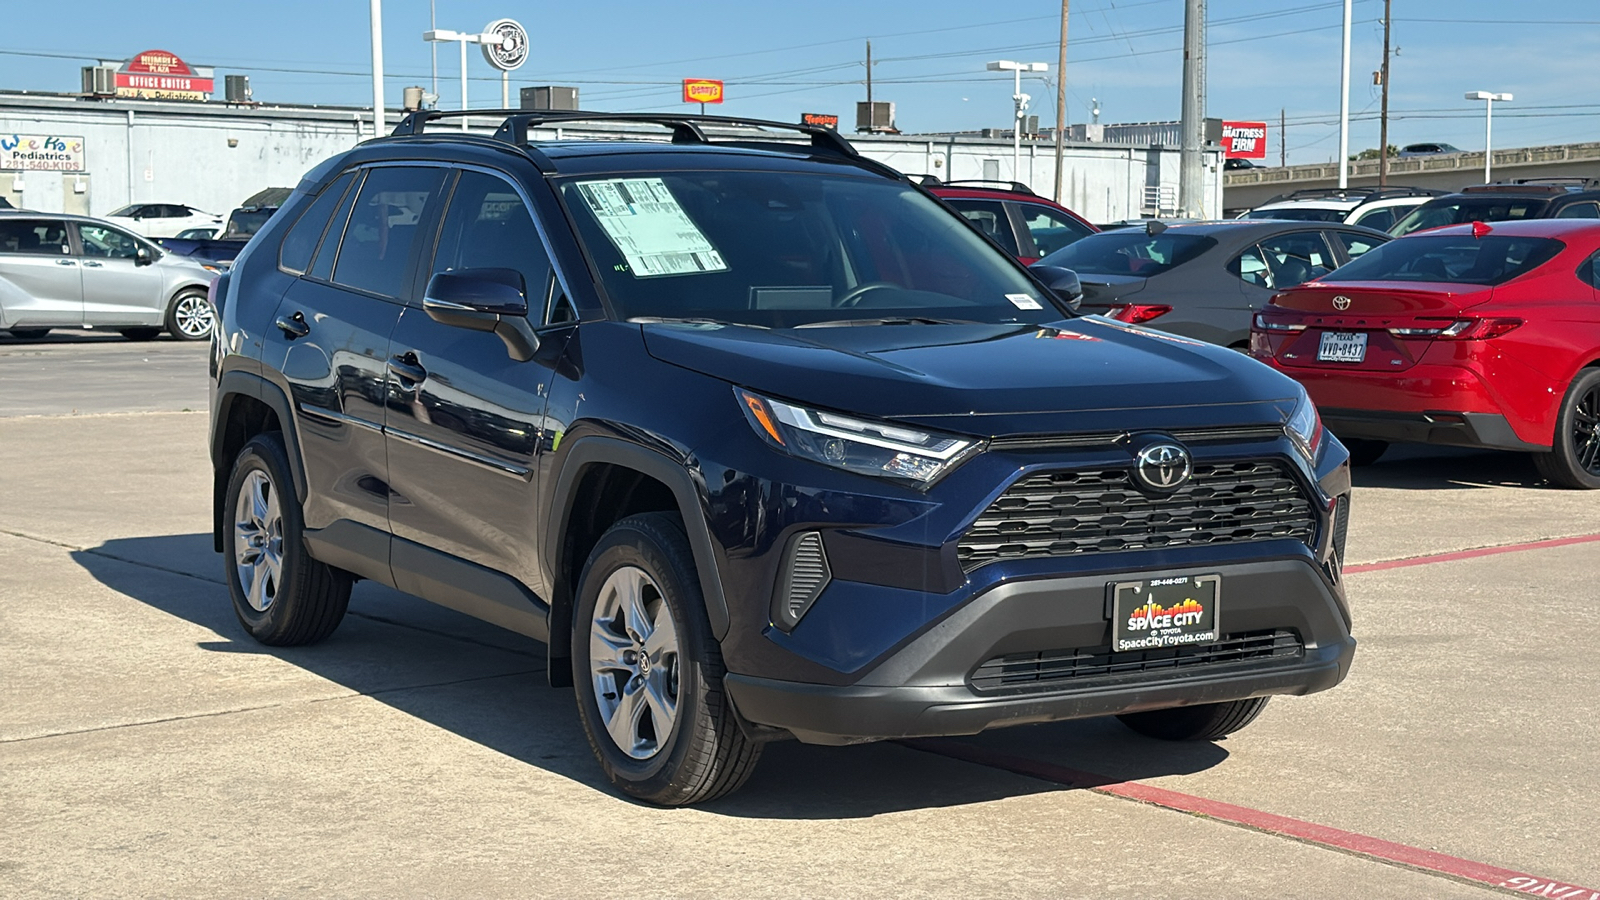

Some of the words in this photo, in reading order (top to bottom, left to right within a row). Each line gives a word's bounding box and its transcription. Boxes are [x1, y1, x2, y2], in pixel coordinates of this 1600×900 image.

[141, 55, 178, 67] HUMBLE
[149, 65, 170, 74] PLAZA
[129, 76, 158, 88] OFFICE
[161, 78, 191, 90] SUITES
[691, 85, 718, 96] Denny's
[1222, 126, 1264, 138] MATTRESS
[1, 134, 40, 151] Wee
[1231, 138, 1256, 152] FIRM
[12, 151, 72, 161] Pediatrics
[5, 160, 80, 171] 281-540-KIDS
[1127, 613, 1171, 631] SPACE
[1173, 610, 1203, 626] CITY
[1160, 628, 1181, 636] TOYOTA
[1119, 632, 1214, 651] SpaceCityToyota.com
